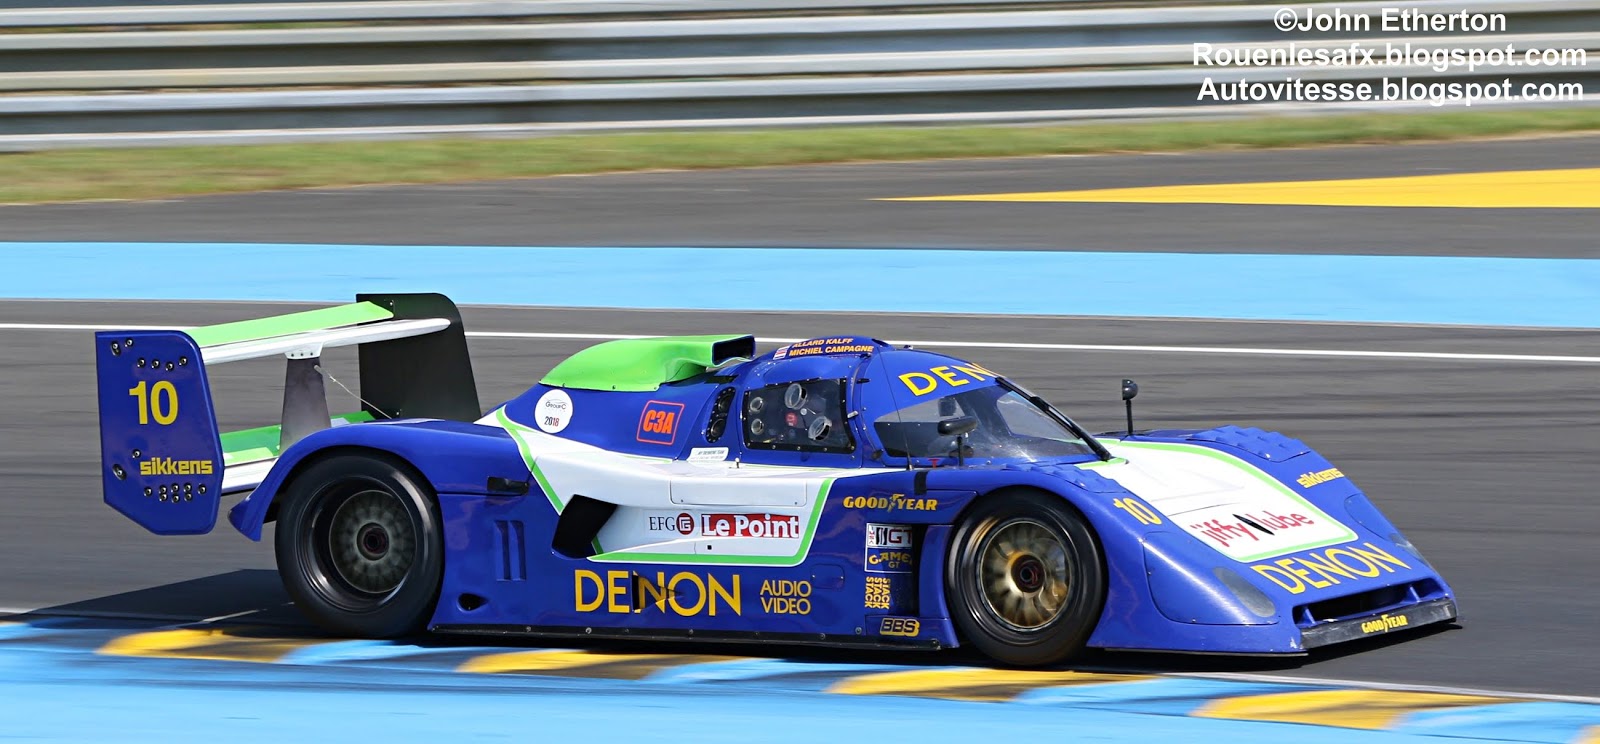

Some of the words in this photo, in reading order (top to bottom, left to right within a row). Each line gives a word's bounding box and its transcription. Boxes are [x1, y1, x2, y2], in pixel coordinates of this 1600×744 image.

[788, 347, 824, 357] MICHIEL
[825, 345, 874, 353] CAMPAGNE
[792, 340, 825, 348] ALLARD
[898, 362, 1000, 397] DEN
[128, 380, 179, 426] 10
[544, 416, 560, 427] 2018
[642, 409, 675, 435] C3A
[139, 457, 213, 475] sikkens
[1296, 467, 1345, 489] sikkens
[1113, 496, 1162, 526] 10
[1244, 510, 1315, 531] lube
[649, 516, 676, 531] EFG
[701, 514, 730, 537] Le
[733, 513, 800, 539] Point
[888, 561, 901, 569] GT
[1250, 542, 1412, 595] DENON
[574, 569, 742, 617] DENON
[759, 580, 812, 598] AUDIO
[760, 597, 812, 615] VIDEO
[880, 619, 920, 634] BBS
